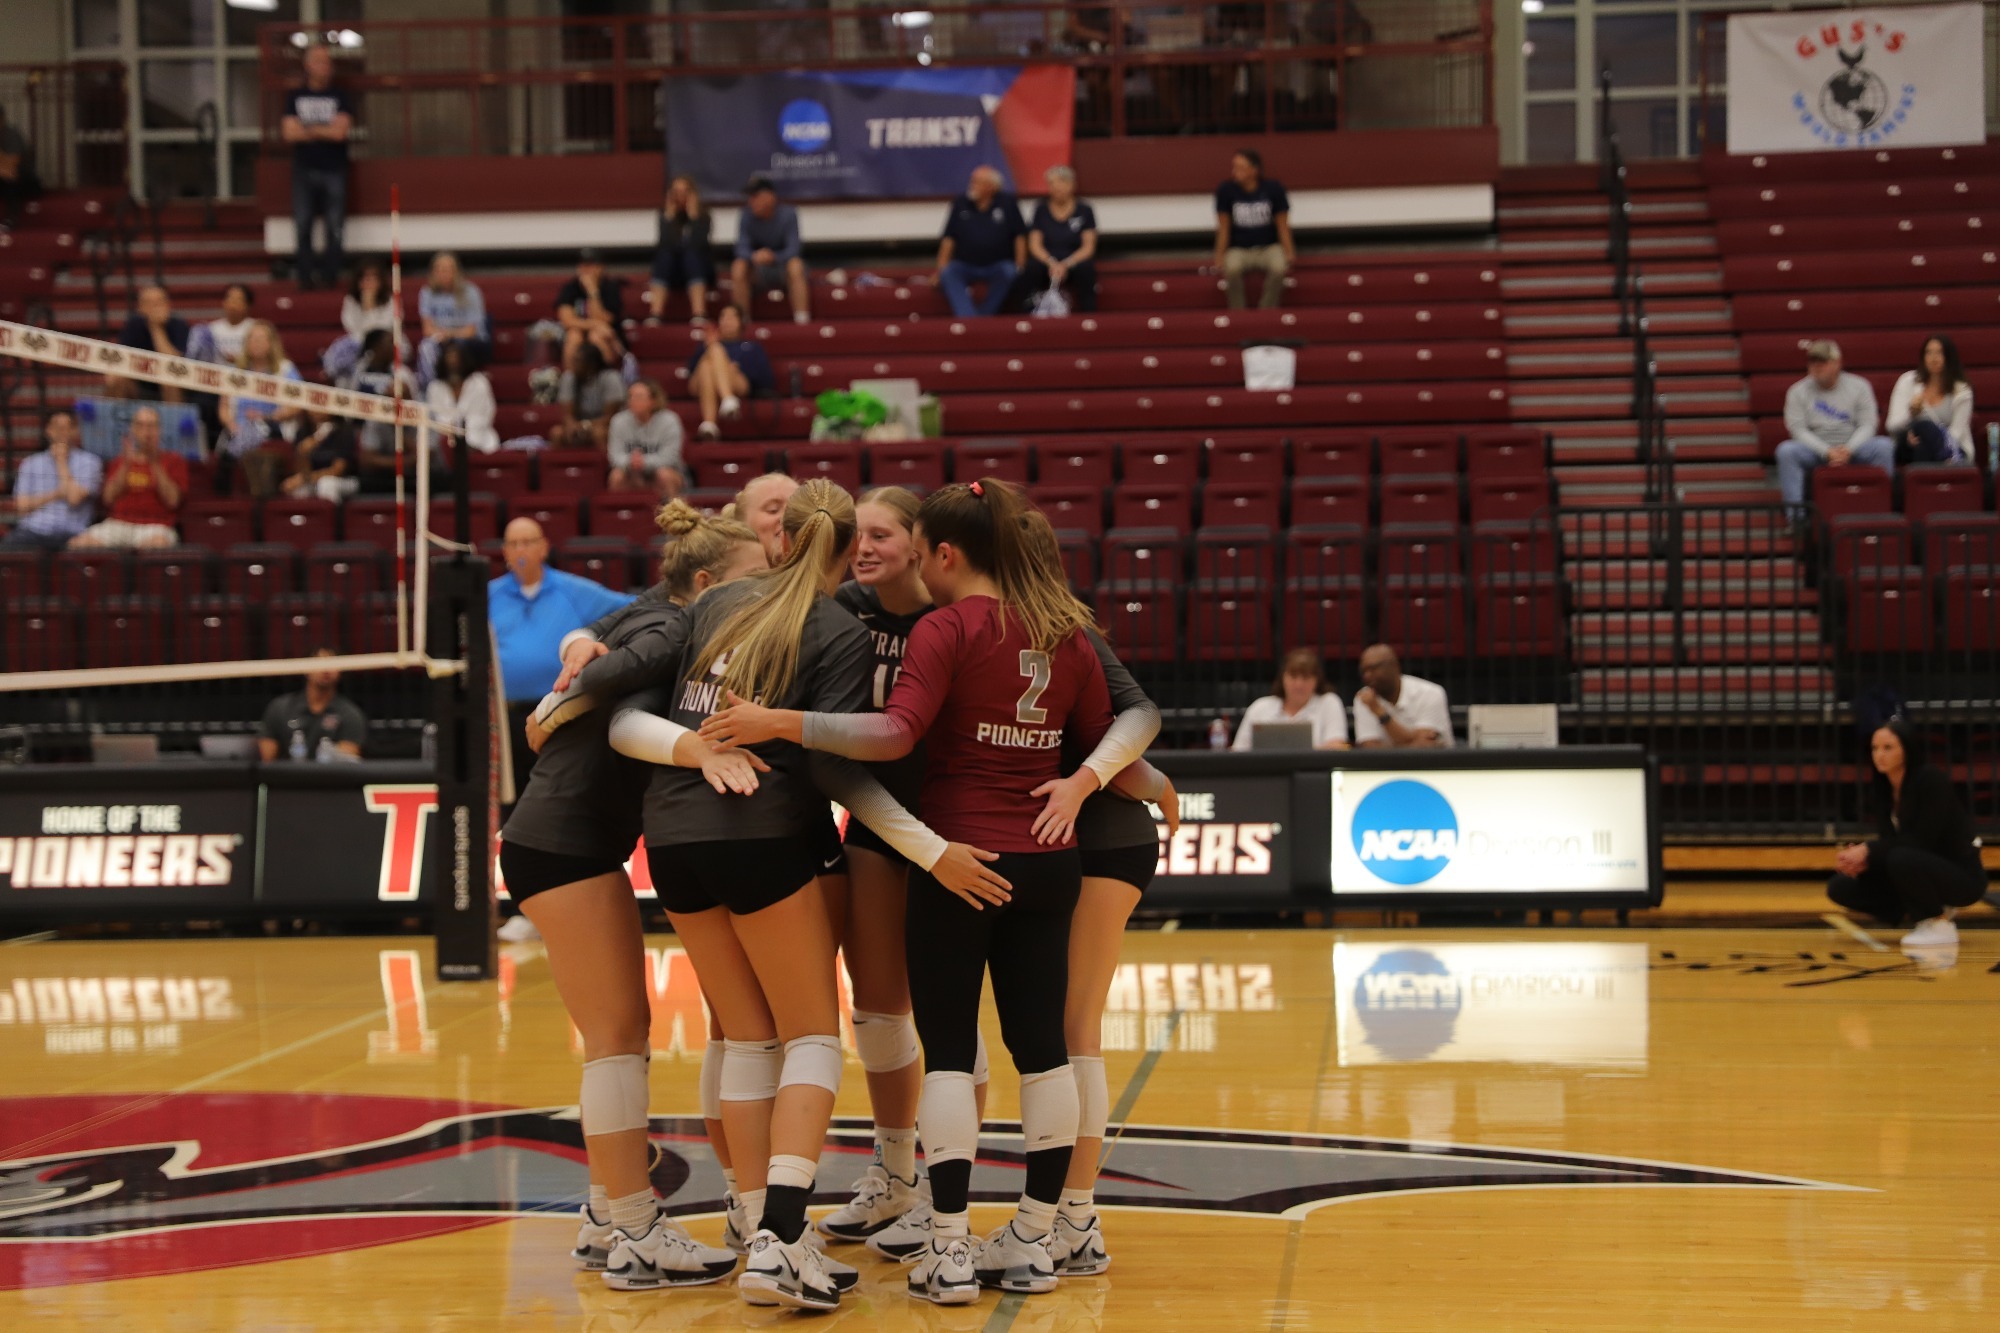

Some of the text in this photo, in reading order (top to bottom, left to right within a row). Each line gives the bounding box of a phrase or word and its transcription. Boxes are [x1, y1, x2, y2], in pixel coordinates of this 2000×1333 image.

[1796, 20, 1906, 59] GUS'S
[866, 116, 981, 148] TRANSY
[1016, 649, 1051, 724] 2
[42, 805, 182, 834] HOME OF THE
[1360, 829, 1459, 861] NCAA
